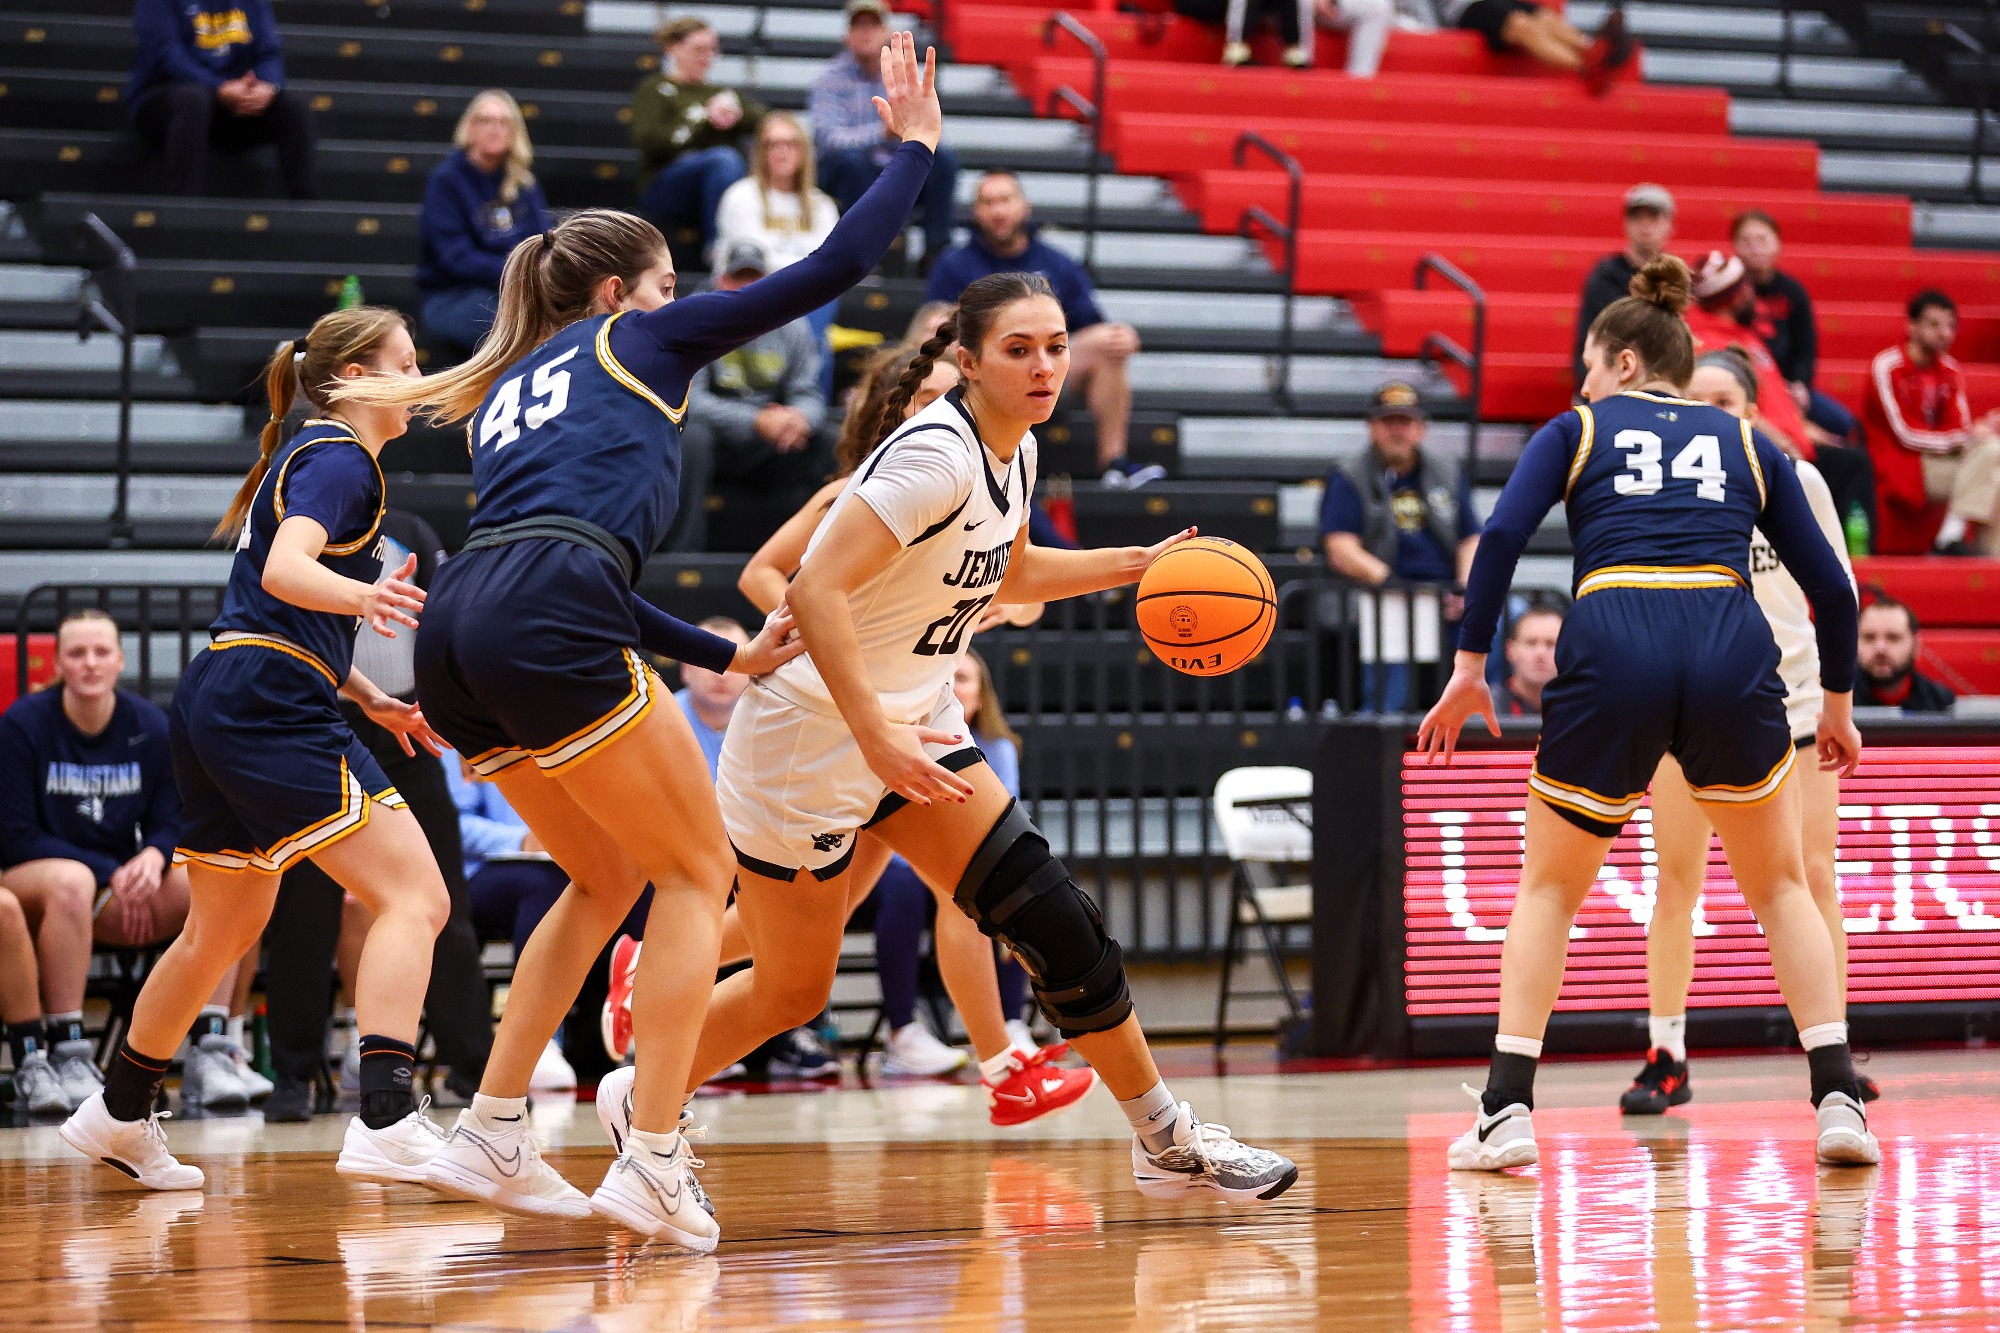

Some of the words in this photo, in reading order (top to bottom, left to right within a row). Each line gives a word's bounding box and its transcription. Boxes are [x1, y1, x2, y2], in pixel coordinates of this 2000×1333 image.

[479, 345, 580, 453] 45
[1613, 429, 1727, 503] 34
[911, 593, 994, 656] 20
[1171, 653, 1222, 670] EVO
[46, 760, 142, 798] AUGUSTANA
